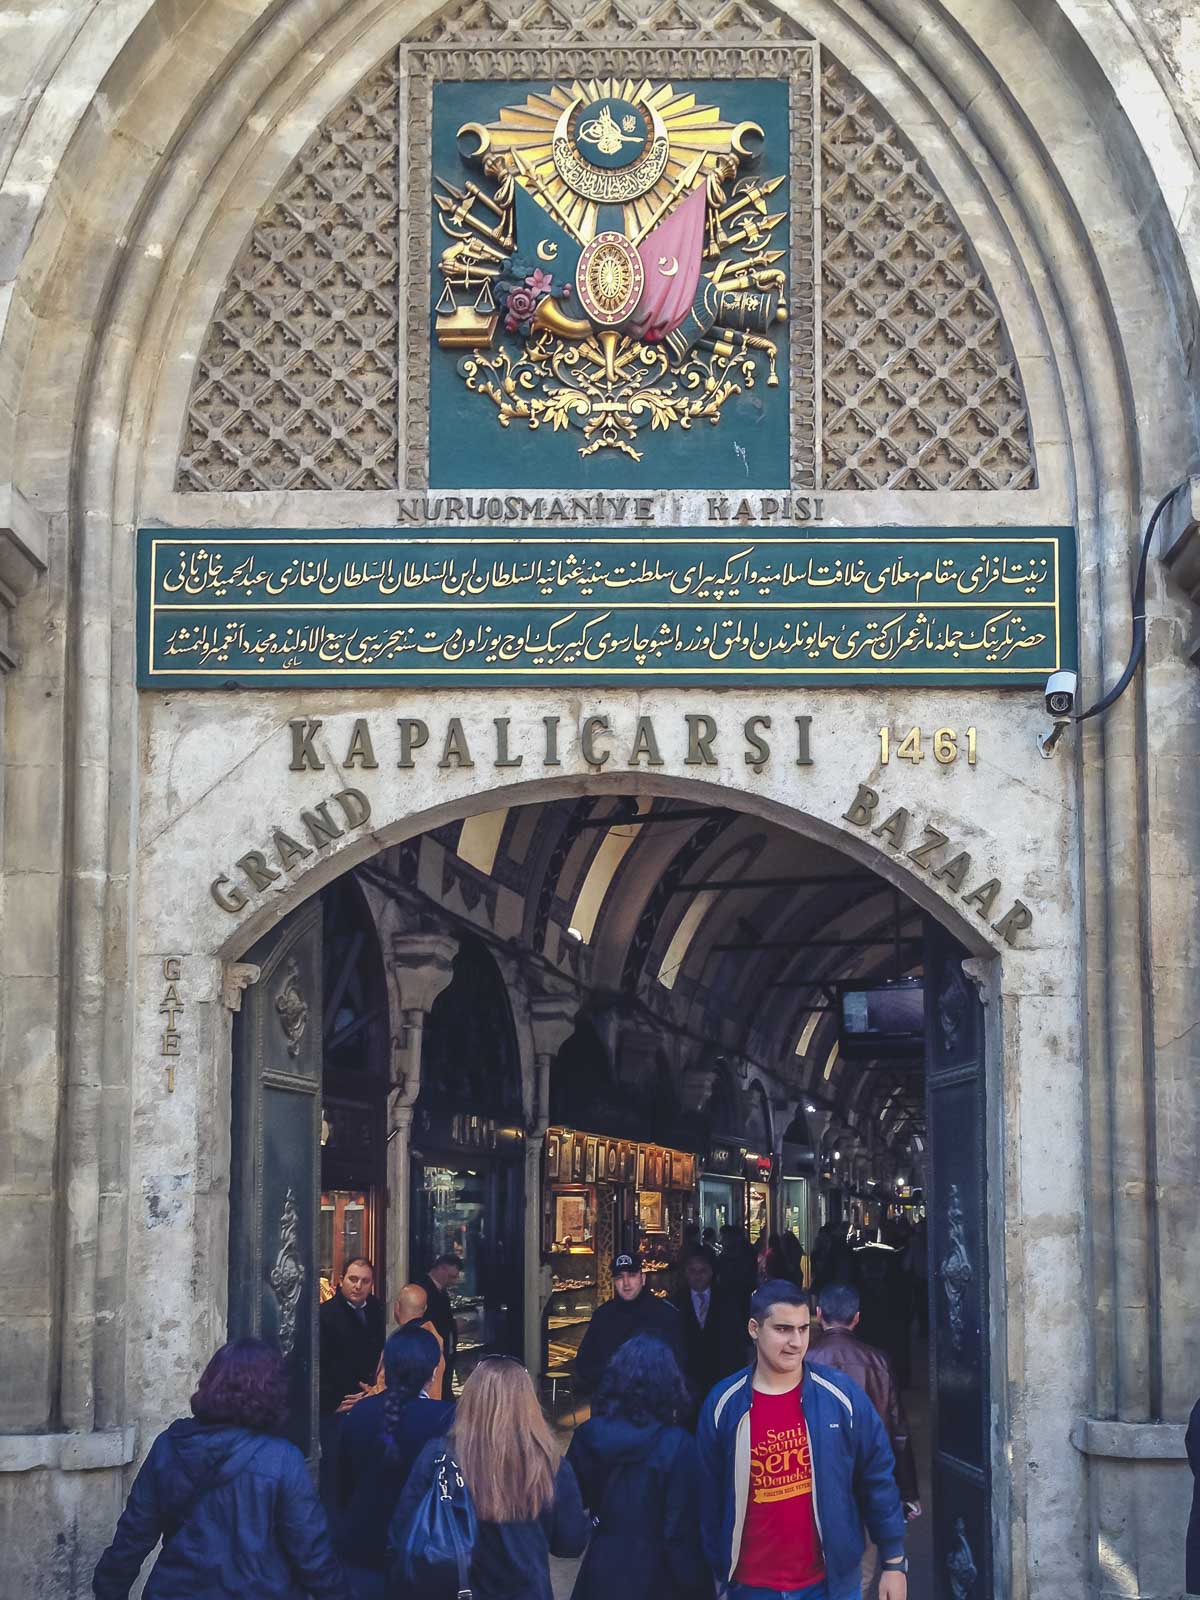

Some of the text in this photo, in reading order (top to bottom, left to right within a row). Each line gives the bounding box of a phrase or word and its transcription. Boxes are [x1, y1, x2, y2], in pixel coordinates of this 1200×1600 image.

[707, 497, 823, 521] KAPISI
[878, 726, 977, 765] 1461
[210, 783, 1034, 946] GRAND BAZAAR
[160, 956, 184, 1093] GATE 1
[757, 1436, 808, 1457] Sevme
[766, 1422, 803, 1444] Seni
